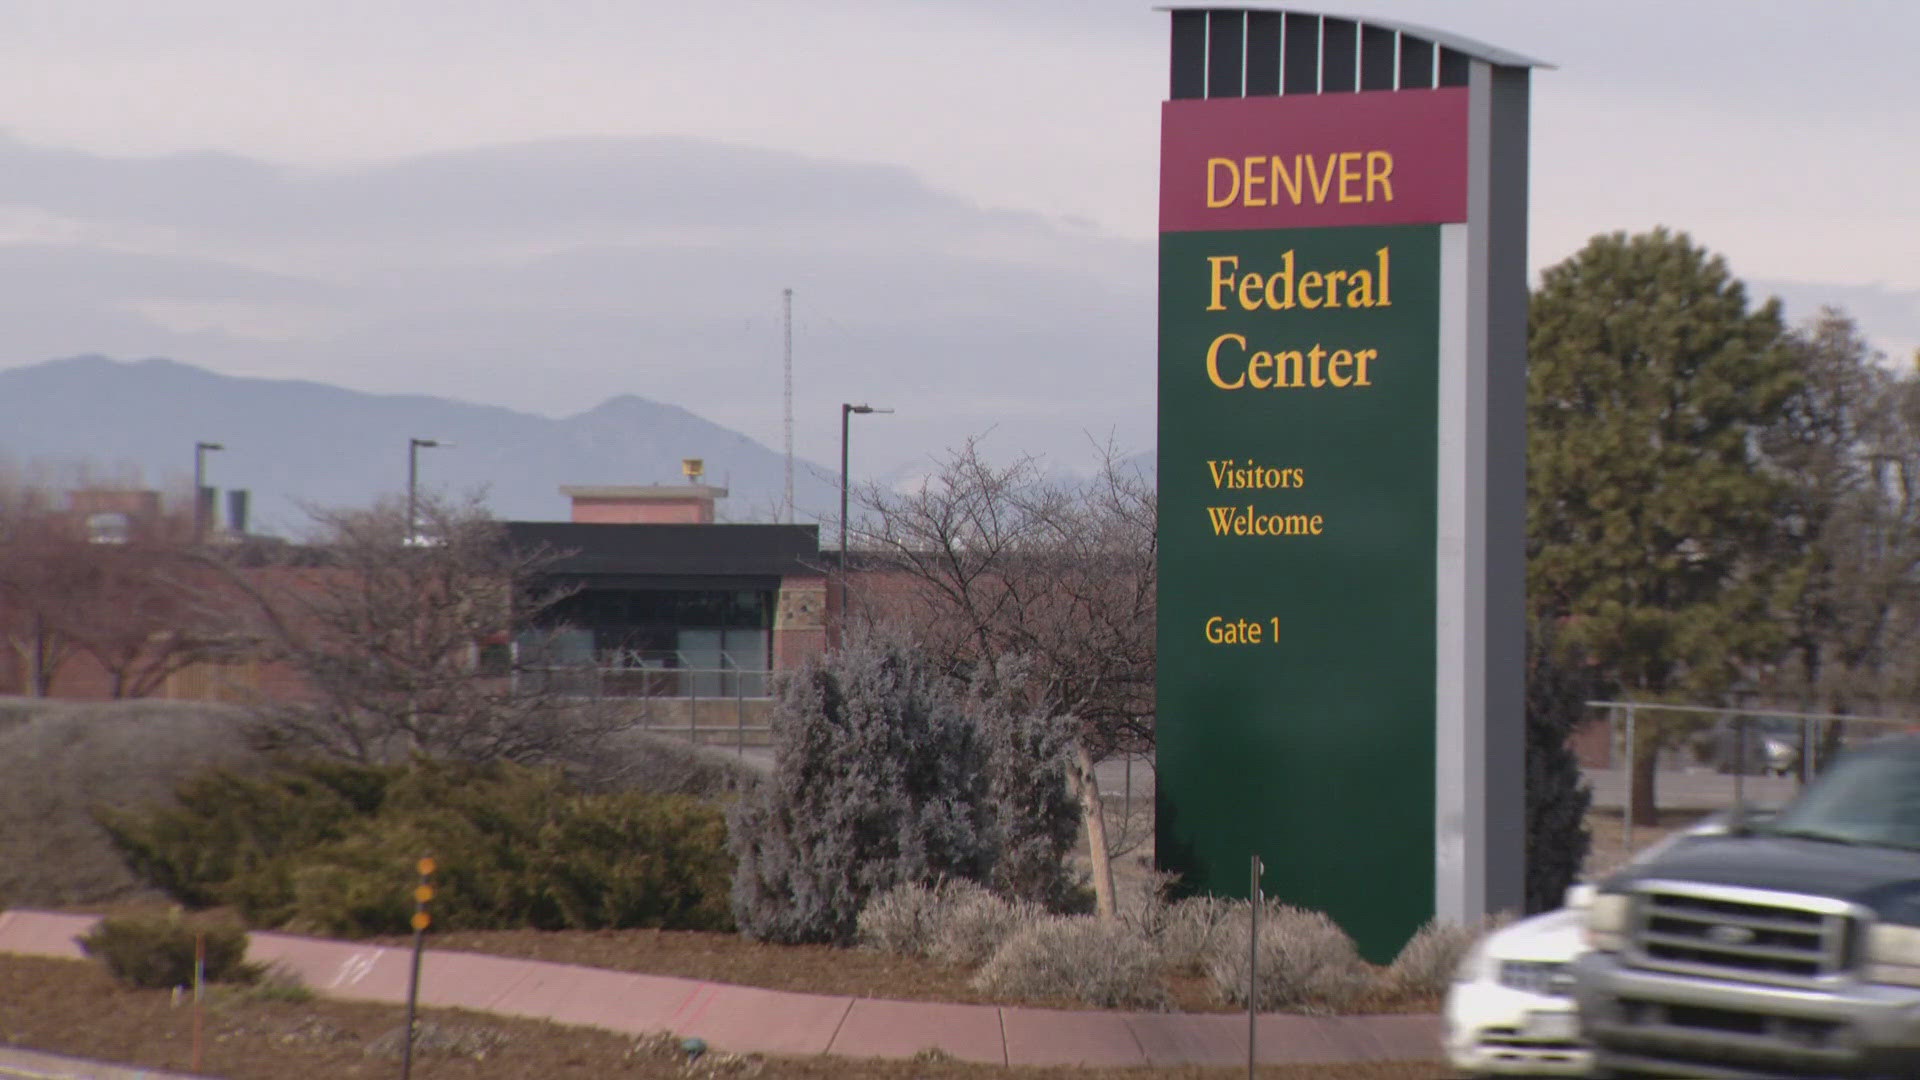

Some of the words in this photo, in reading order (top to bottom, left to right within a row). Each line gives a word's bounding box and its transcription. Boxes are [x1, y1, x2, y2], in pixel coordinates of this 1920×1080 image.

[1206, 150, 1393, 208] DENVER
[1206, 247, 1392, 311] Federal
[1206, 333, 1378, 390] Center
[1207, 459, 1304, 489] Visitors
[1207, 504, 1323, 536] Welcome
[1205, 616, 1261, 644] Gate
[1270, 616, 1279, 643] 1
